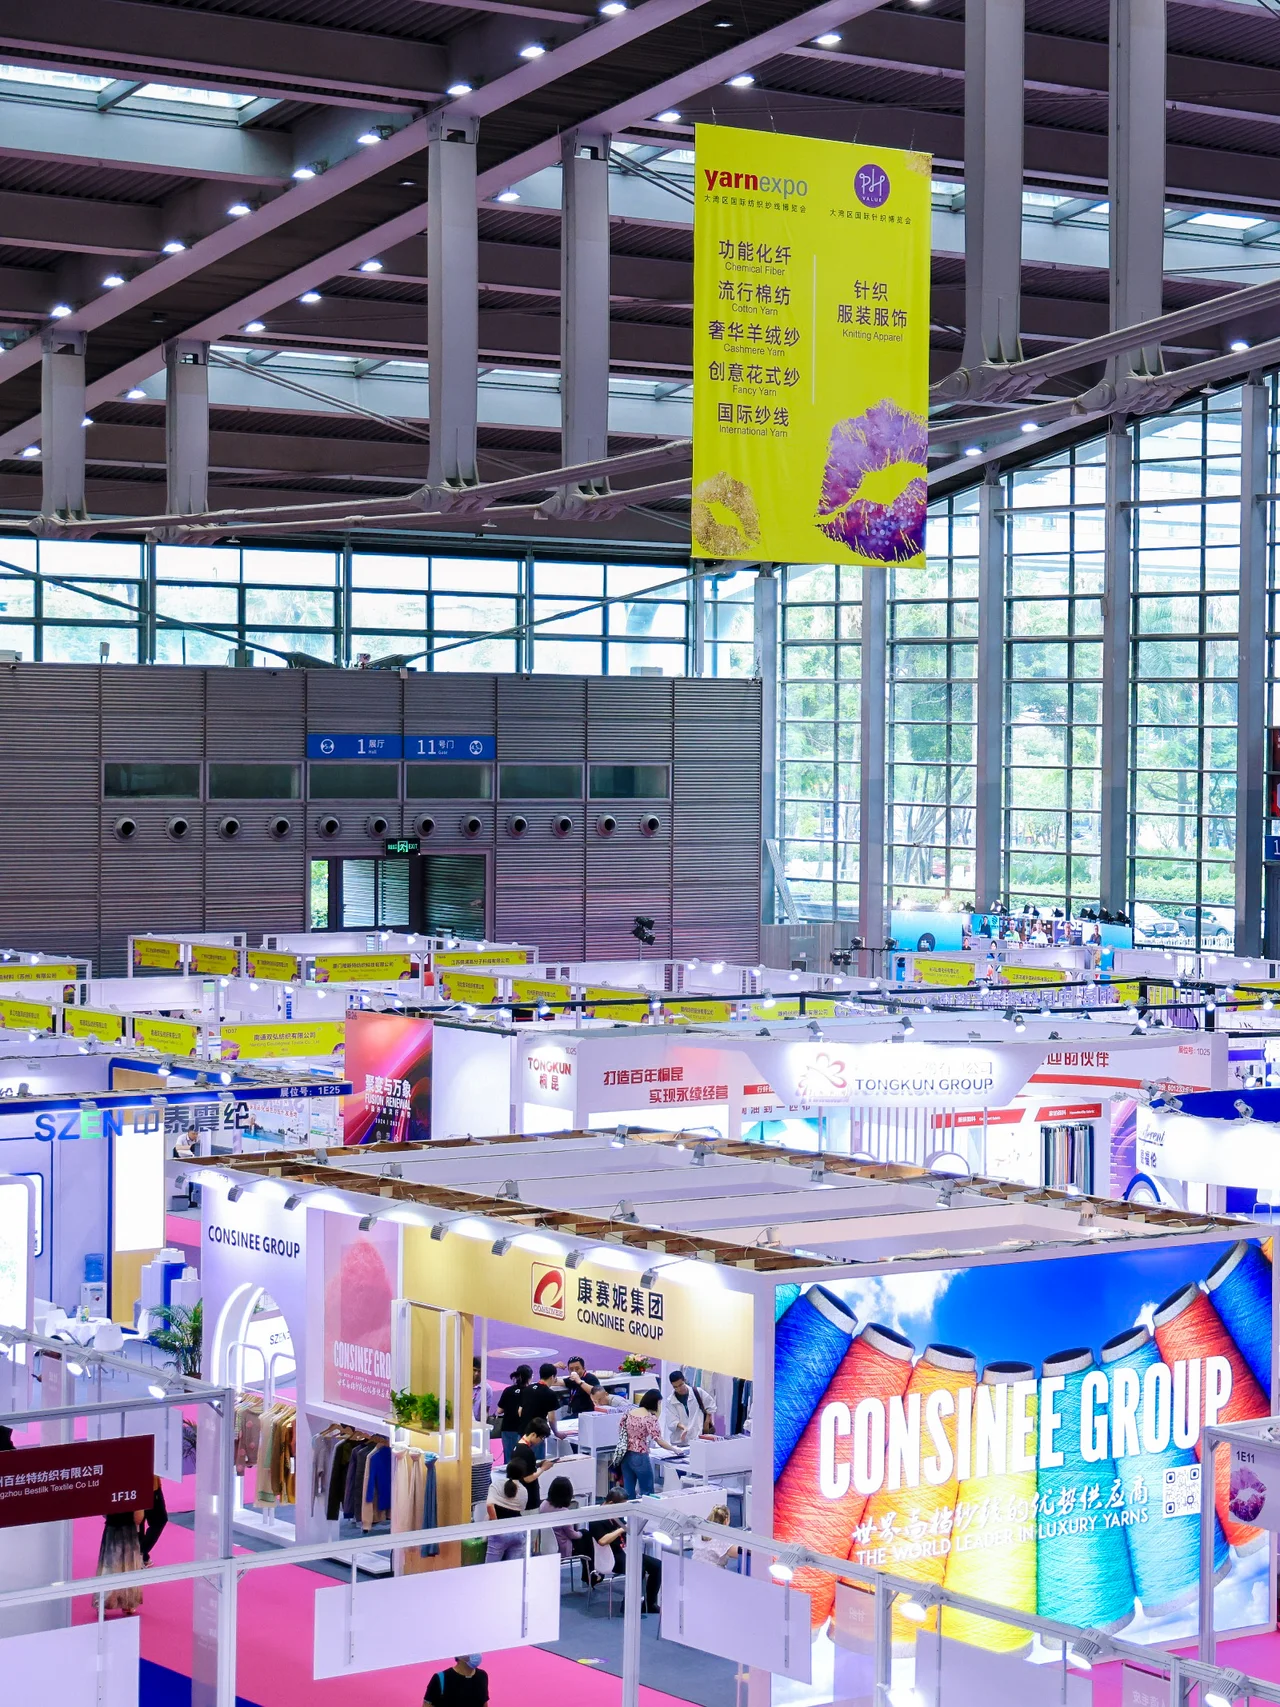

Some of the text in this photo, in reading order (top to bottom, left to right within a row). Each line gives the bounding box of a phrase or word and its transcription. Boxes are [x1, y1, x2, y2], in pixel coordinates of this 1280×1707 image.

[704, 169, 808, 199] yarnexpo
[704, 195, 807, 214] 大湾区国际纺织纱线博览会
[830, 209, 912, 225] 大湾区国际针织博览会
[718, 240, 791, 265] 功能化纤
[725, 261, 785, 276] Chemical Fiber
[718, 280, 791, 306] 流行棉纺
[854, 280, 888, 301] 针织
[732, 303, 778, 316] Cotton Yarn
[837, 304, 908, 328] 服装服饰
[708, 320, 800, 347] 奢华羊绒纱
[842, 329, 903, 343] Knitting Apparel
[723, 343, 785, 357] Cashmere Yarn
[708, 361, 800, 387] 创意花式纱
[732, 385, 777, 397] Fancy Yarn
[717, 403, 789, 427] 国际纱线
[719, 425, 788, 438] International Yarn
[357, 739, 455, 755] 1 展厅 11 号门
[1274, 839, 1280, 855] 1
[527, 1057, 572, 1076] TONGKUN
[365, 1074, 411, 1098] 聚变与万象
[539, 1075, 559, 1091] 桐昆
[604, 1067, 684, 1086] 打造百年桐昆
[855, 1077, 994, 1092] TONGKUN GROUP
[317, 1085, 341, 1096] 1E25
[365, 1093, 384, 1106] FUSION
[650, 1085, 729, 1104] 实现永续经营
[34, 1109, 124, 1142] SZEN
[208, 1225, 300, 1259] CONSINEE GROUP
[577, 1277, 664, 1321] 康赛妮集团
[577, 1308, 664, 1341] CONSINEE GROUP
[334, 1340, 373, 1376] CONSINEE
[818, 1355, 1233, 1500] CONSINEE GROUP
[1236, 1450, 1256, 1464] 1E11
[24, 1479, 100, 1496] Bestilk Textile Co Ltd
[111, 1489, 137, 1503] 1F18
[857, 1507, 1149, 1566] THE WORLD LEADER IN LUXURY YARNS
